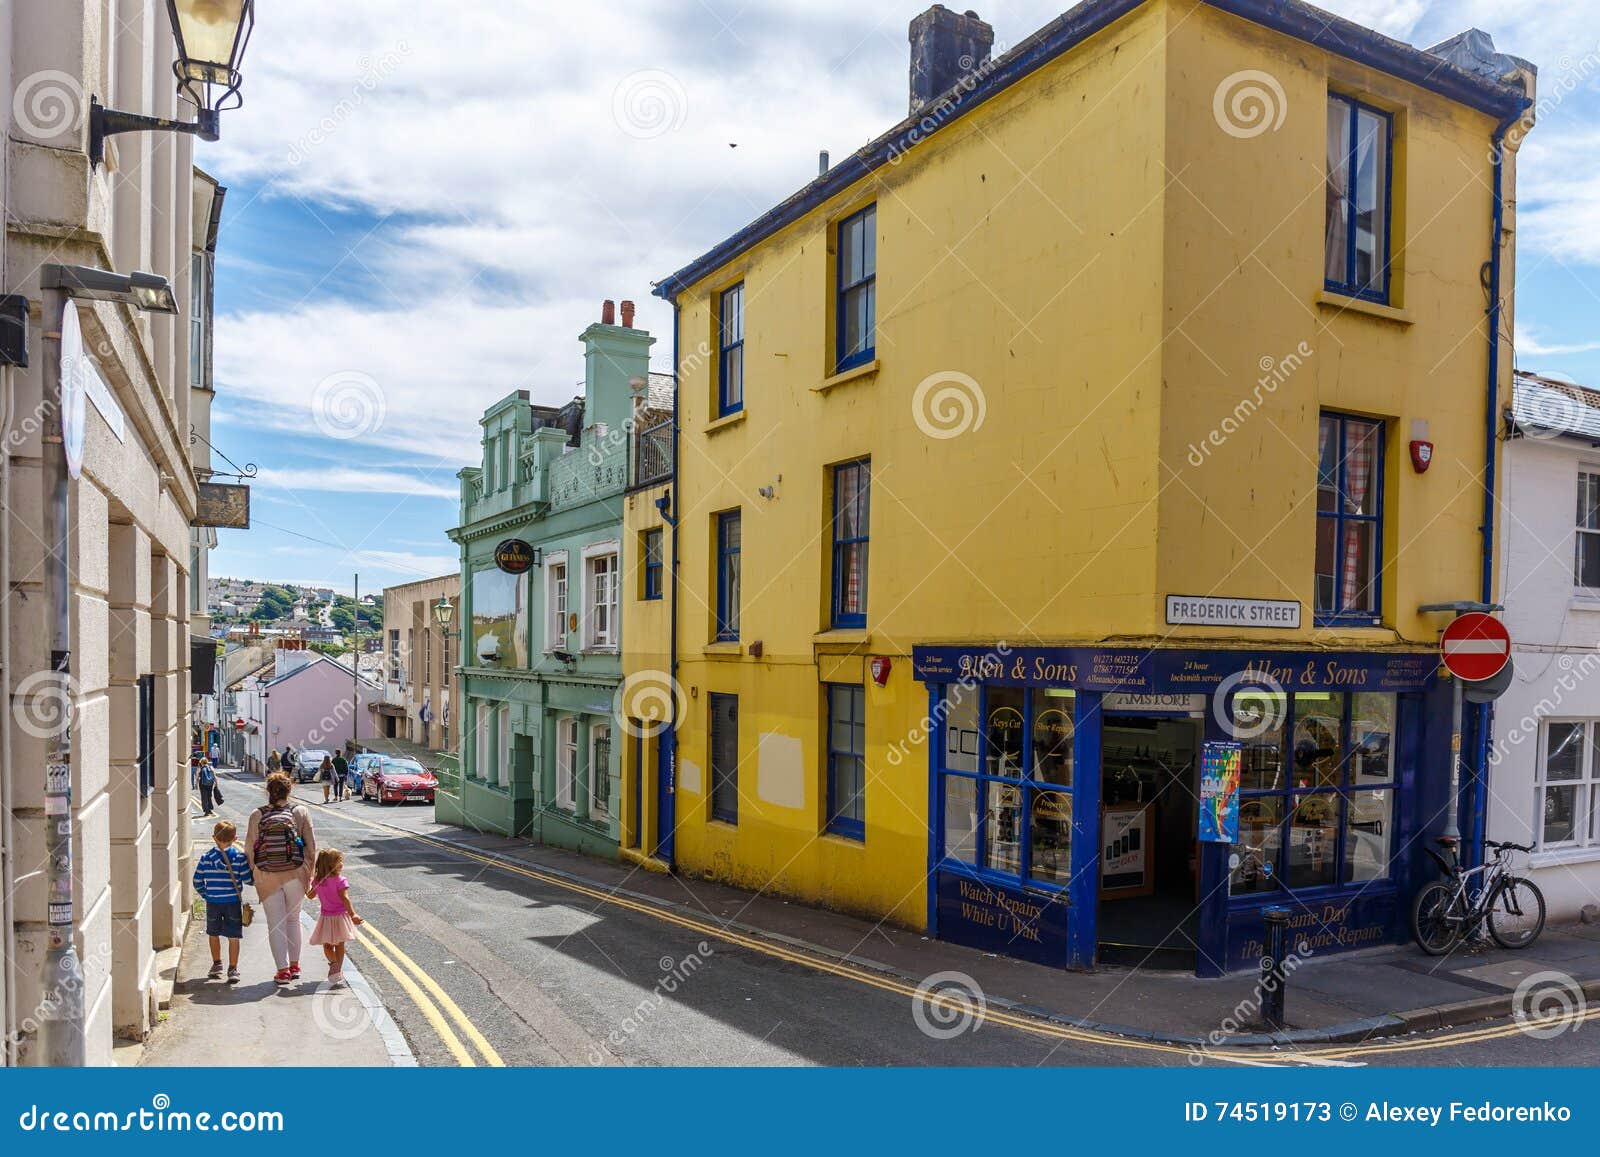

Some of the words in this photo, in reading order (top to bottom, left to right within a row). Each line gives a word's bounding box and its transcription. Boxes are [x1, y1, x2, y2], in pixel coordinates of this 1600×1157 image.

[1173, 602, 1245, 620] FREDERICK
[1250, 605, 1296, 621] STREET
[960, 655, 1004, 678] Allen
[1011, 656, 1027, 680] &
[1032, 656, 1078, 682] Sons
[1093, 655, 1113, 664] 01273
[1183, 661, 1192, 670] 24
[1193, 662, 1209, 670] hour
[1170, 673, 1201, 682] locksmith
[1239, 660, 1293, 685] Allen
[1300, 660, 1317, 685] &
[1323, 661, 1368, 685] Sons
[992, 717, 1008, 729] Keys
[1009, 719, 1022, 729] Cut
[960, 880, 992, 905] Watch
[996, 891, 1040, 919] Repairs
[962, 902, 994, 926] While
[998, 914, 1008, 930] U
[1012, 917, 1040, 941] Wait
[1322, 905, 1351, 925] Day
[1241, 939, 1263, 960] iPa
[1293, 932, 1333, 951] Phone
[1338, 925, 1384, 943] Repairs
